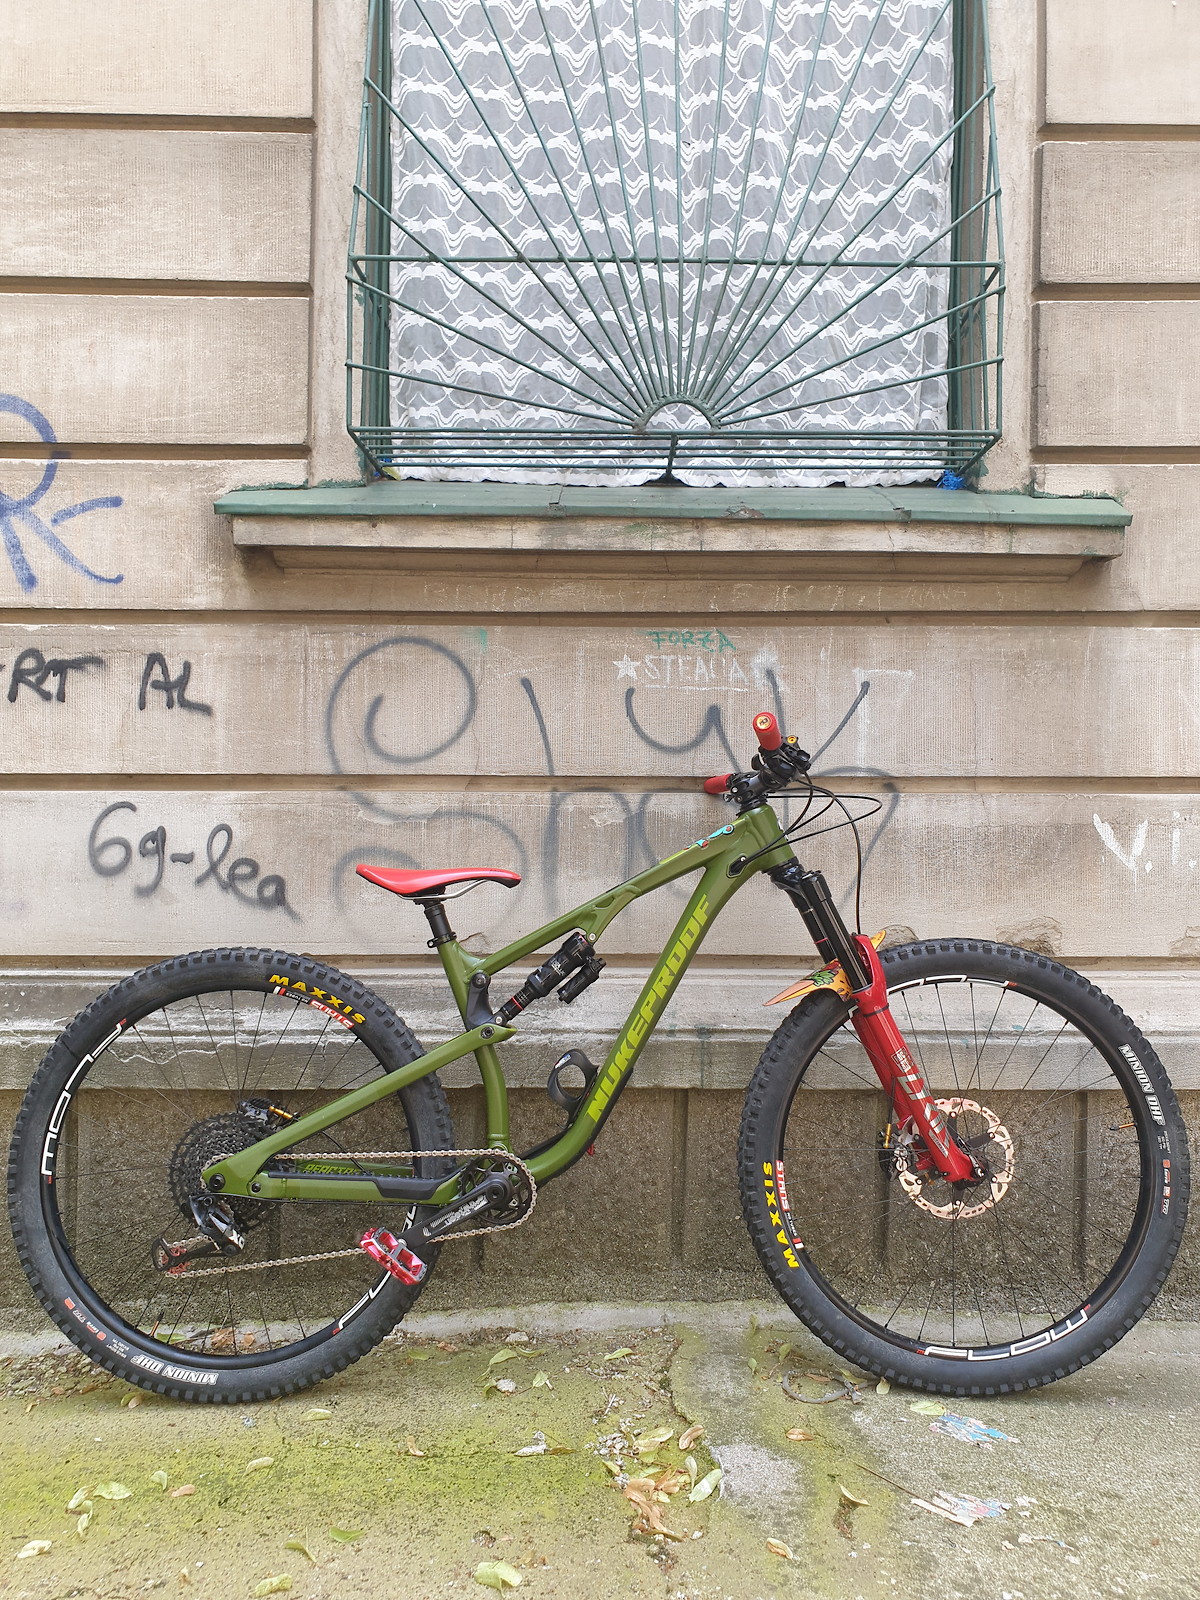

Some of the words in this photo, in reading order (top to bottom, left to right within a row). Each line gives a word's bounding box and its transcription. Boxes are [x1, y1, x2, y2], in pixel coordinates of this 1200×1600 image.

[647, 629, 737, 653] FORZA
[269, 974, 366, 1024] MAXXIS
[586, 893, 710, 1123] NUKEPROOF
[1118, 1044, 1155, 1093] MINION
[1145, 1095, 1166, 1126] DHF
[776, 1160, 790, 1211] STANS
[763, 1161, 799, 1268] MAXXIS
[130, 1354, 165, 1375] DHF
[162, 1365, 219, 1386] MINION
